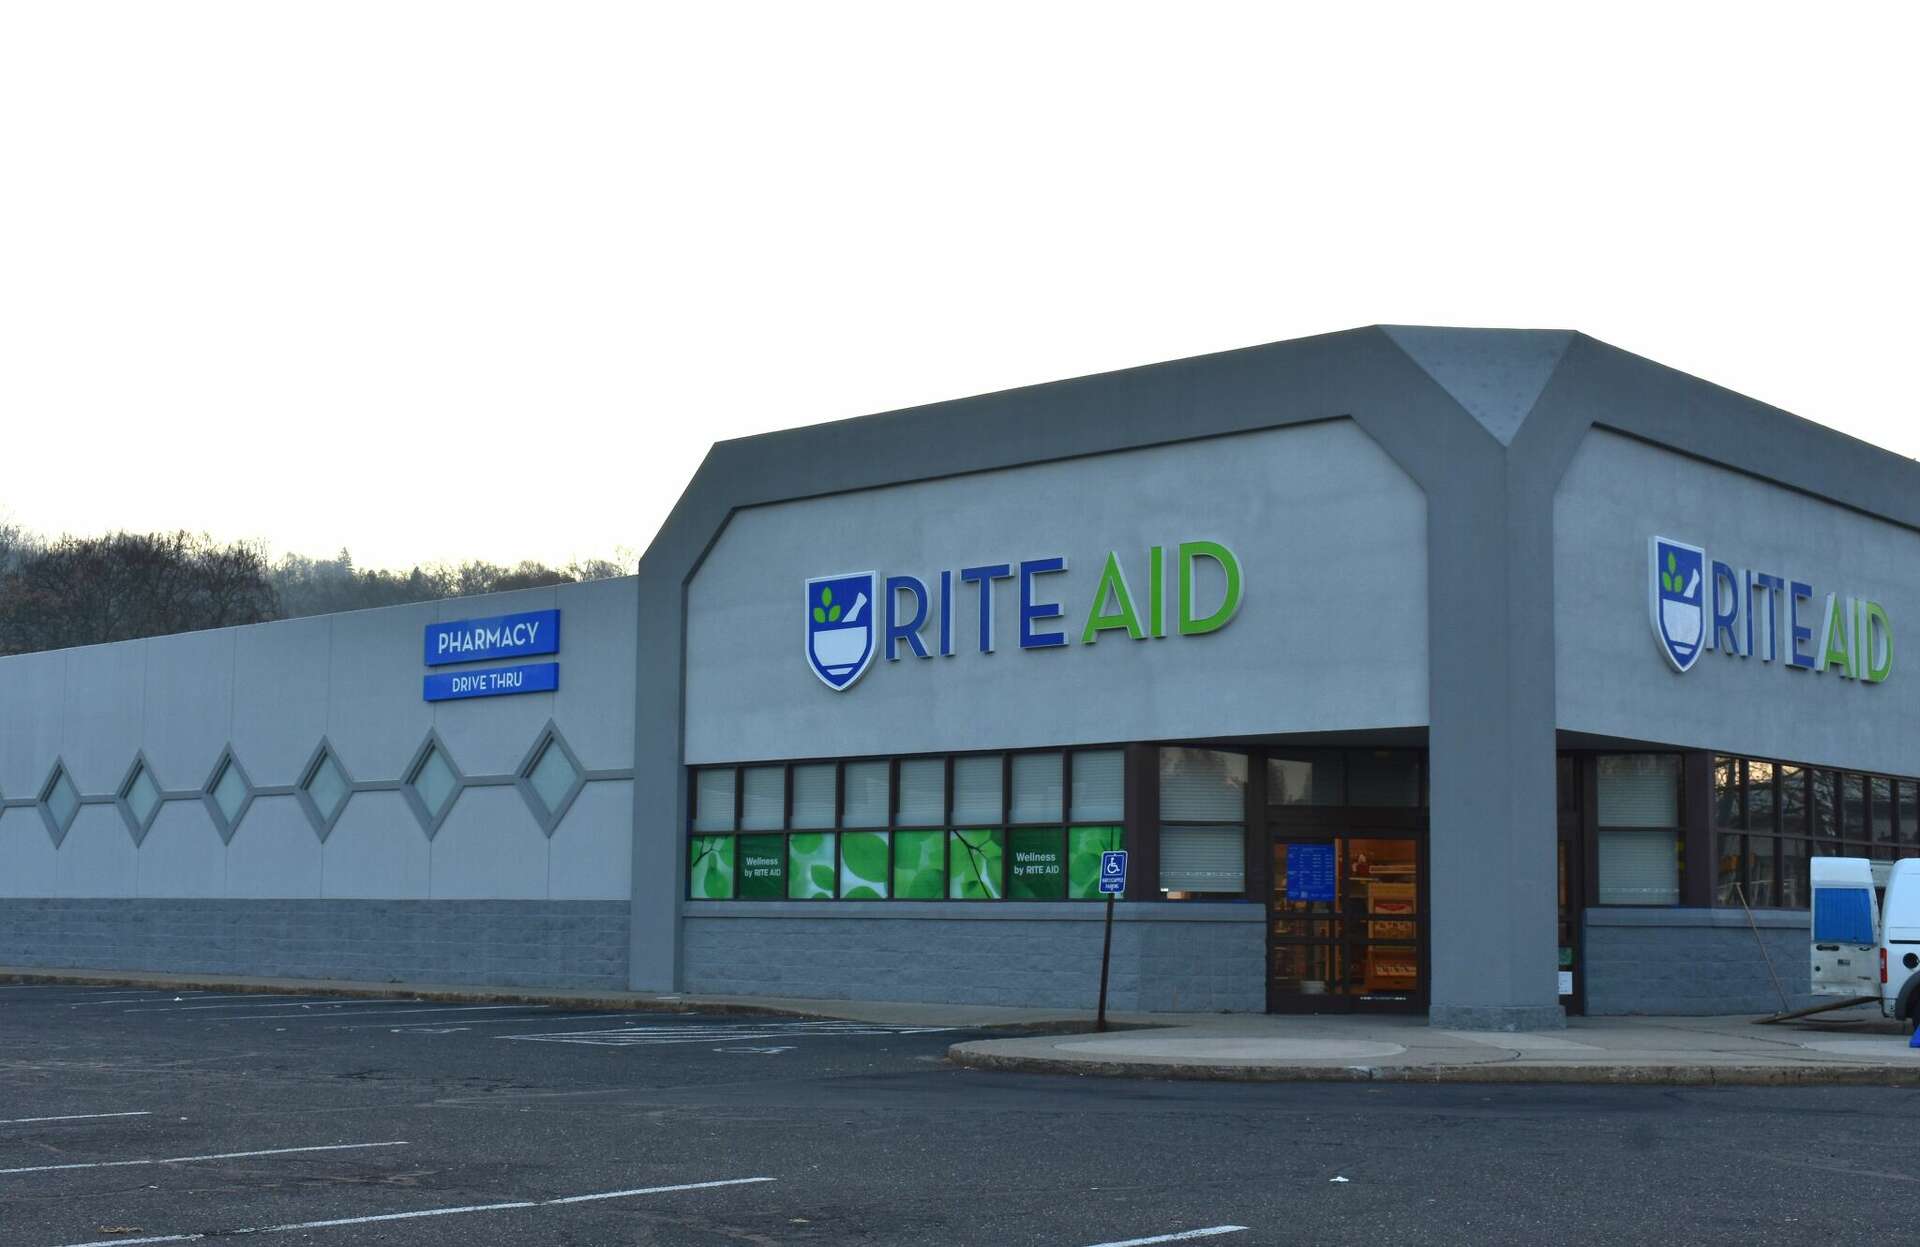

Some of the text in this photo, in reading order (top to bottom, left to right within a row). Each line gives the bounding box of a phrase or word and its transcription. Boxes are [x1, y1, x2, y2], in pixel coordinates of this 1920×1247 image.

[885, 540, 1244, 661] RITE AID
[1706, 560, 1893, 682] RITE AID
[438, 621, 539, 654] PHARMACY
[452, 671, 522, 692] DRIVE THRU
[745, 856, 778, 866] Wellness
[1015, 852, 1056, 862] Wellness
[1014, 865, 1060, 876] by RITE AID
